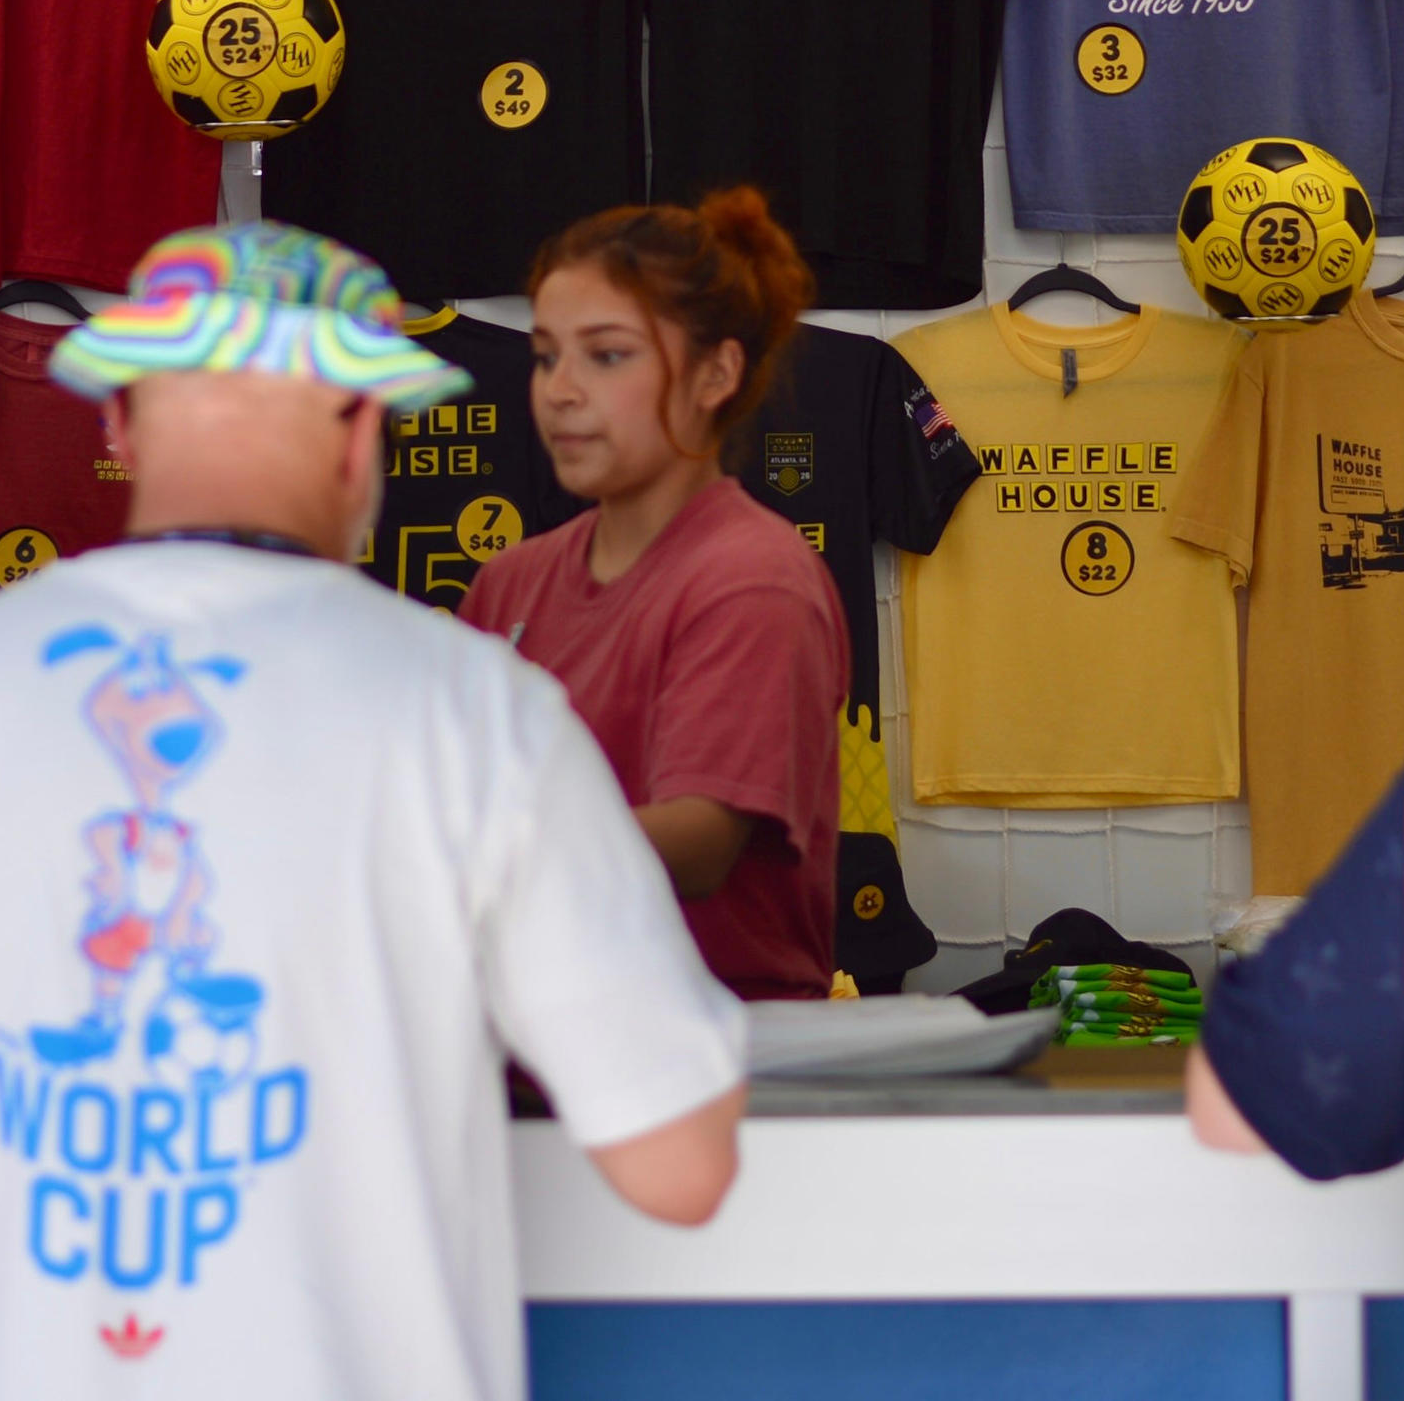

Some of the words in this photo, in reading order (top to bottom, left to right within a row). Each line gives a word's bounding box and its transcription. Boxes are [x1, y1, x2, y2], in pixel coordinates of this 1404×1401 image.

[219, 18, 261, 46] 25
[1101, 34, 1120, 61] 3
[505, 69, 524, 96] 2
[1092, 64, 1128, 83] $32
[494, 99, 531, 117] $49
[1227, 180, 1262, 204] WH
[1296, 179, 1332, 205] WH
[1258, 217, 1300, 246] 25
[980, 445, 1176, 472] WAFFLE
[1331, 438, 1381, 461] WAFFLE
[1333, 458, 1382, 478] HOUSE
[999, 483, 1159, 510] HOUSE
[482, 503, 502, 530] 7
[15, 536, 36, 564] 6
[469, 534, 506, 551] $43
[1087, 532, 1107, 559] 8
[5, 565, 39, 583] $2
[1078, 564, 1117, 583] $22
[28, 1174, 240, 1292] CUP
